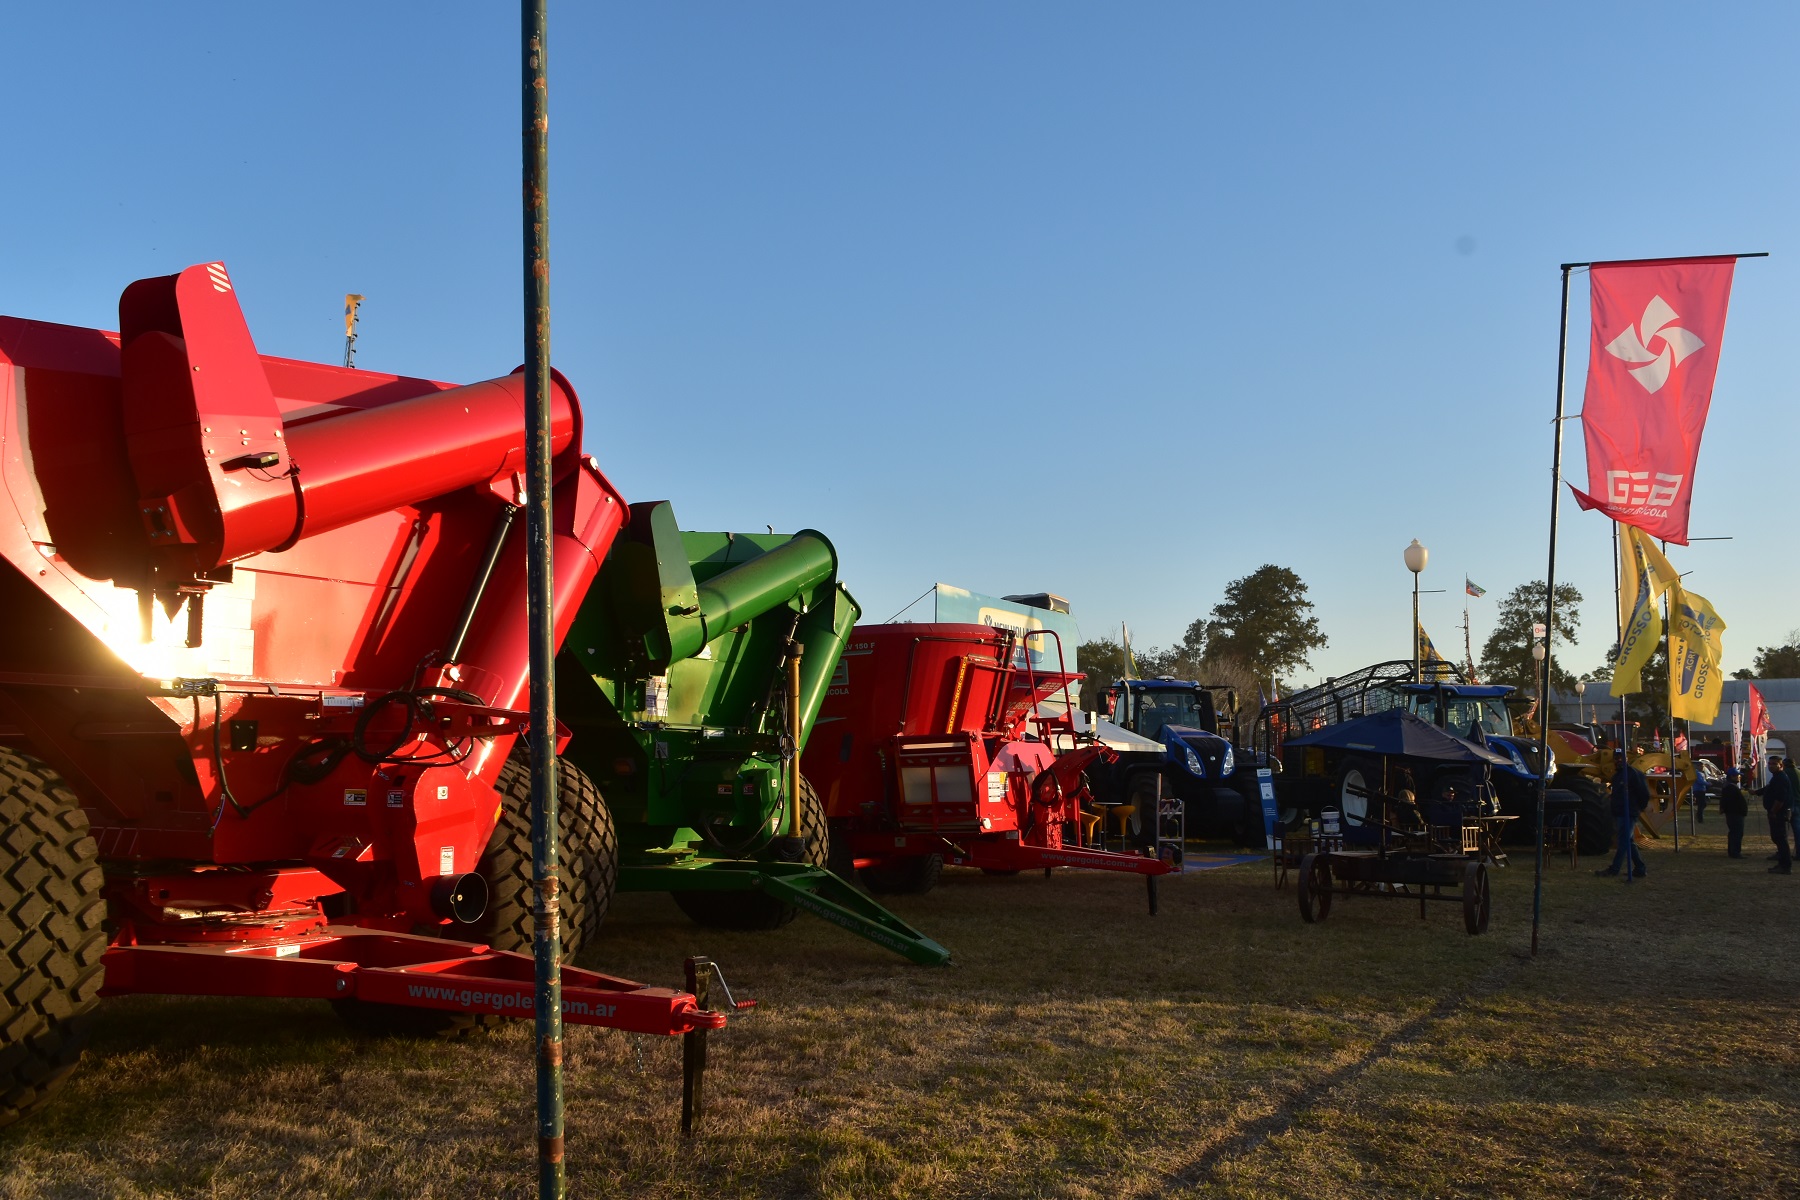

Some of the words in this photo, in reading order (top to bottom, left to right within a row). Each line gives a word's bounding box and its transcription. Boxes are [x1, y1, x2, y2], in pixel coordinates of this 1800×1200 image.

[855, 642, 869, 650] 150
[1620, 610, 1652, 666] GROSSO
[1040, 852, 1139, 869] www.gergolet.com.ar
[793, 894, 910, 952] www.gergolt.com.ar
